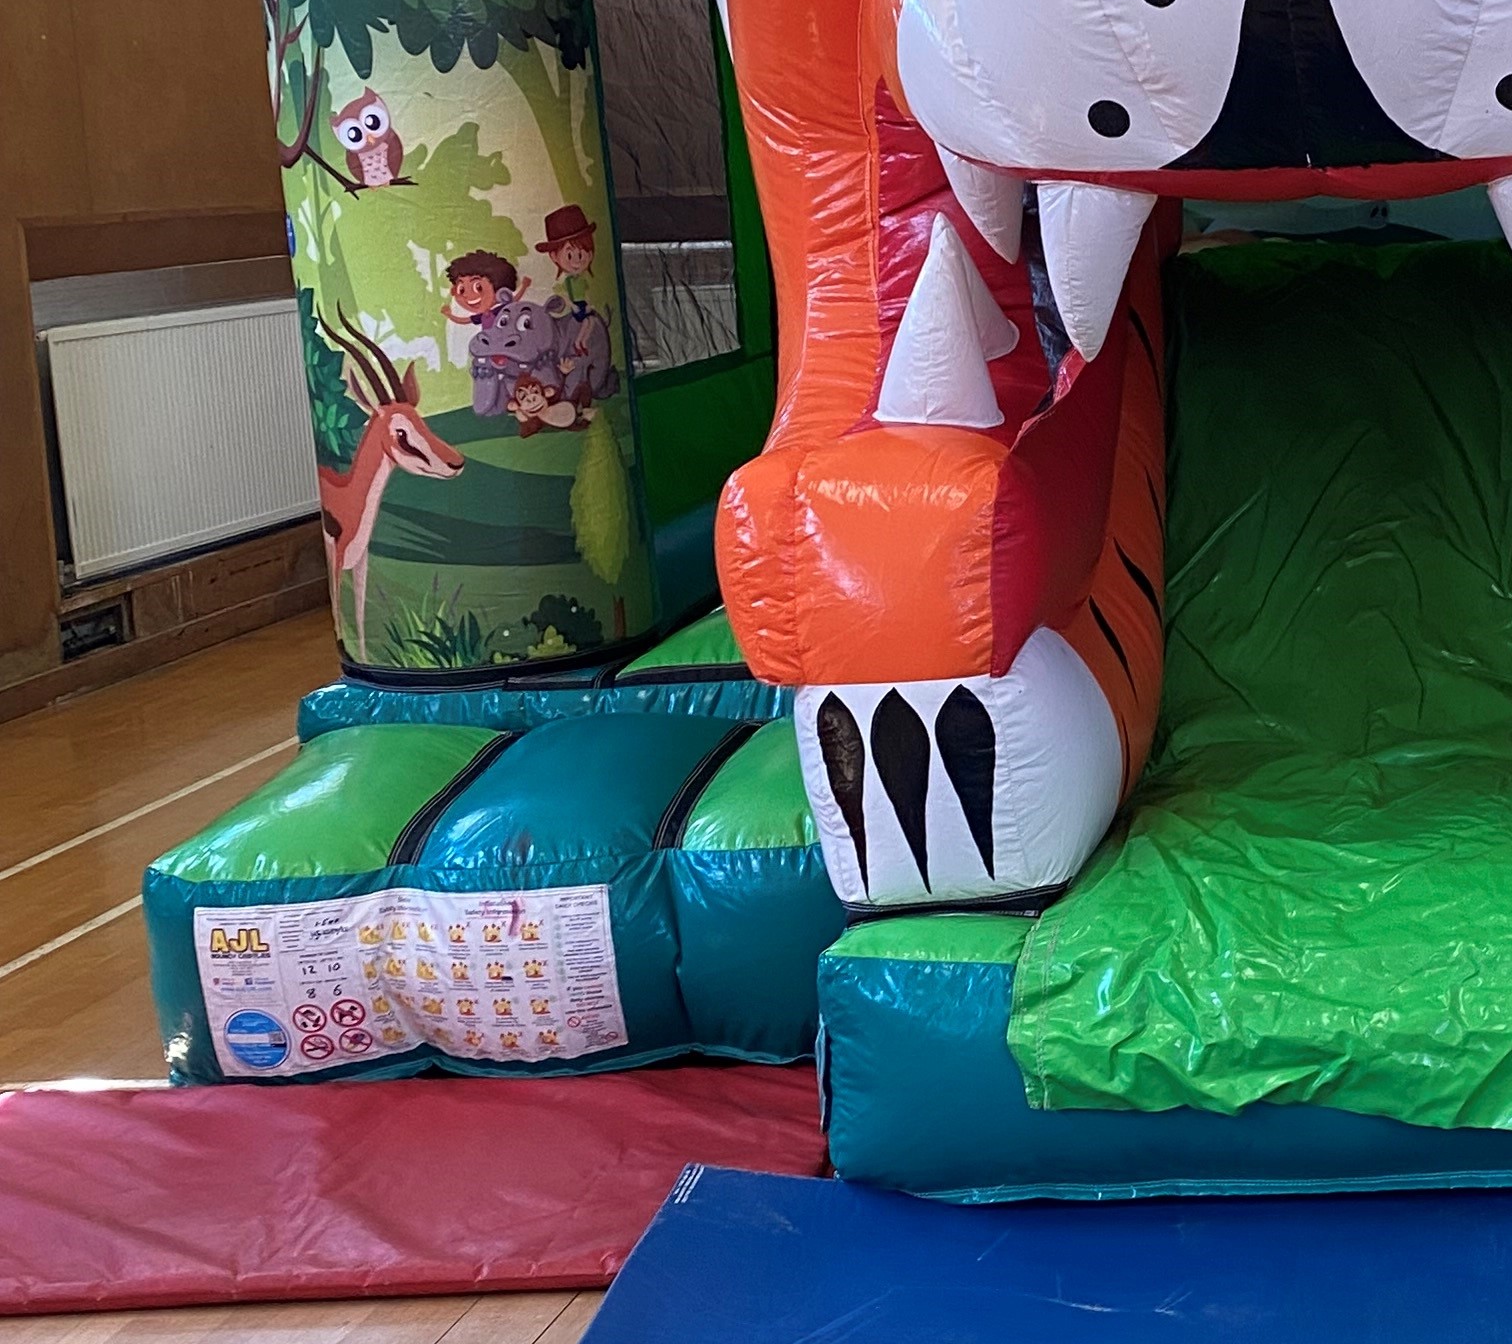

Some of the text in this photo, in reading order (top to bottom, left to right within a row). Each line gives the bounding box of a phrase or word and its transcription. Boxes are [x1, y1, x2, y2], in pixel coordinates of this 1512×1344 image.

[210, 927, 270, 953] AJL
[302, 962, 341, 976] 12 10
[306, 984, 342, 999] 8 6
